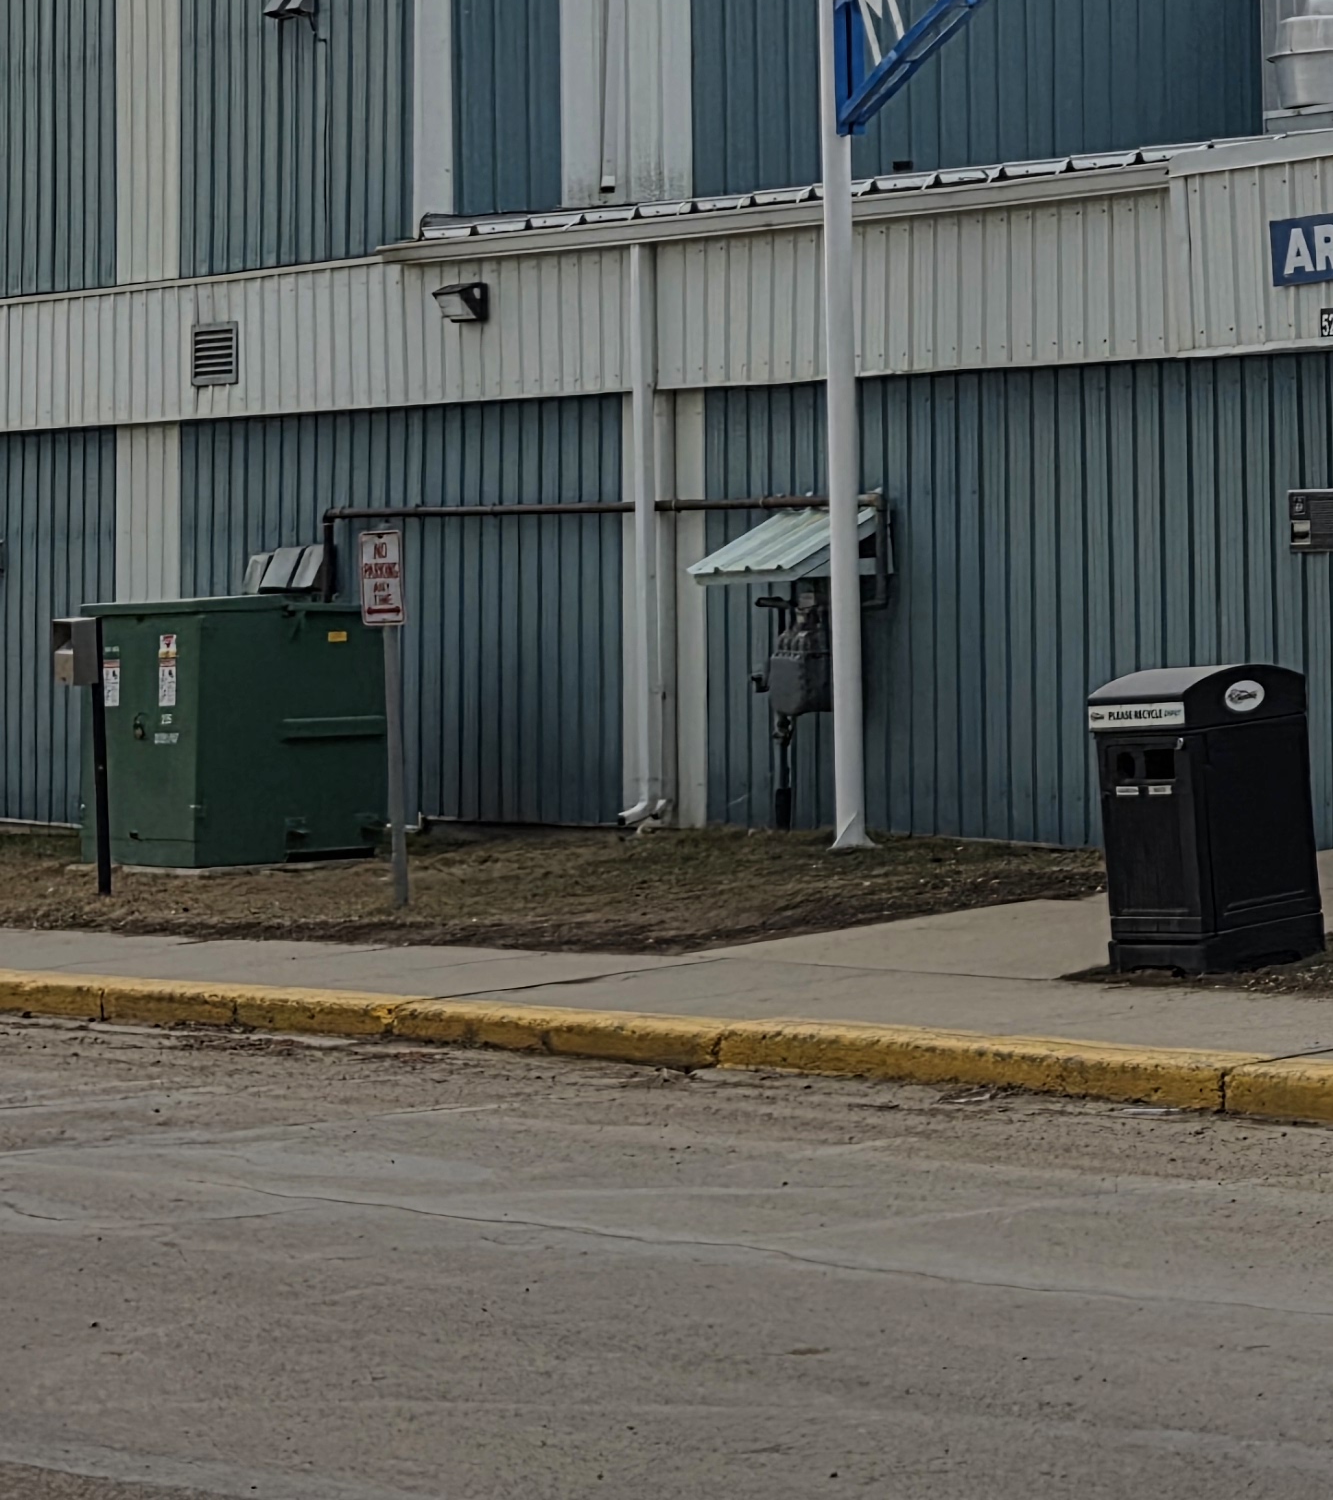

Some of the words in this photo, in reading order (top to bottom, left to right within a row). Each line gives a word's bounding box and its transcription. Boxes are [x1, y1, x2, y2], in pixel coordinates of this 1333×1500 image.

[374, 542, 388, 559] NO
[1108, 710, 1133, 721] PLEASE
[1134, 708, 1163, 720] RECYCLE
